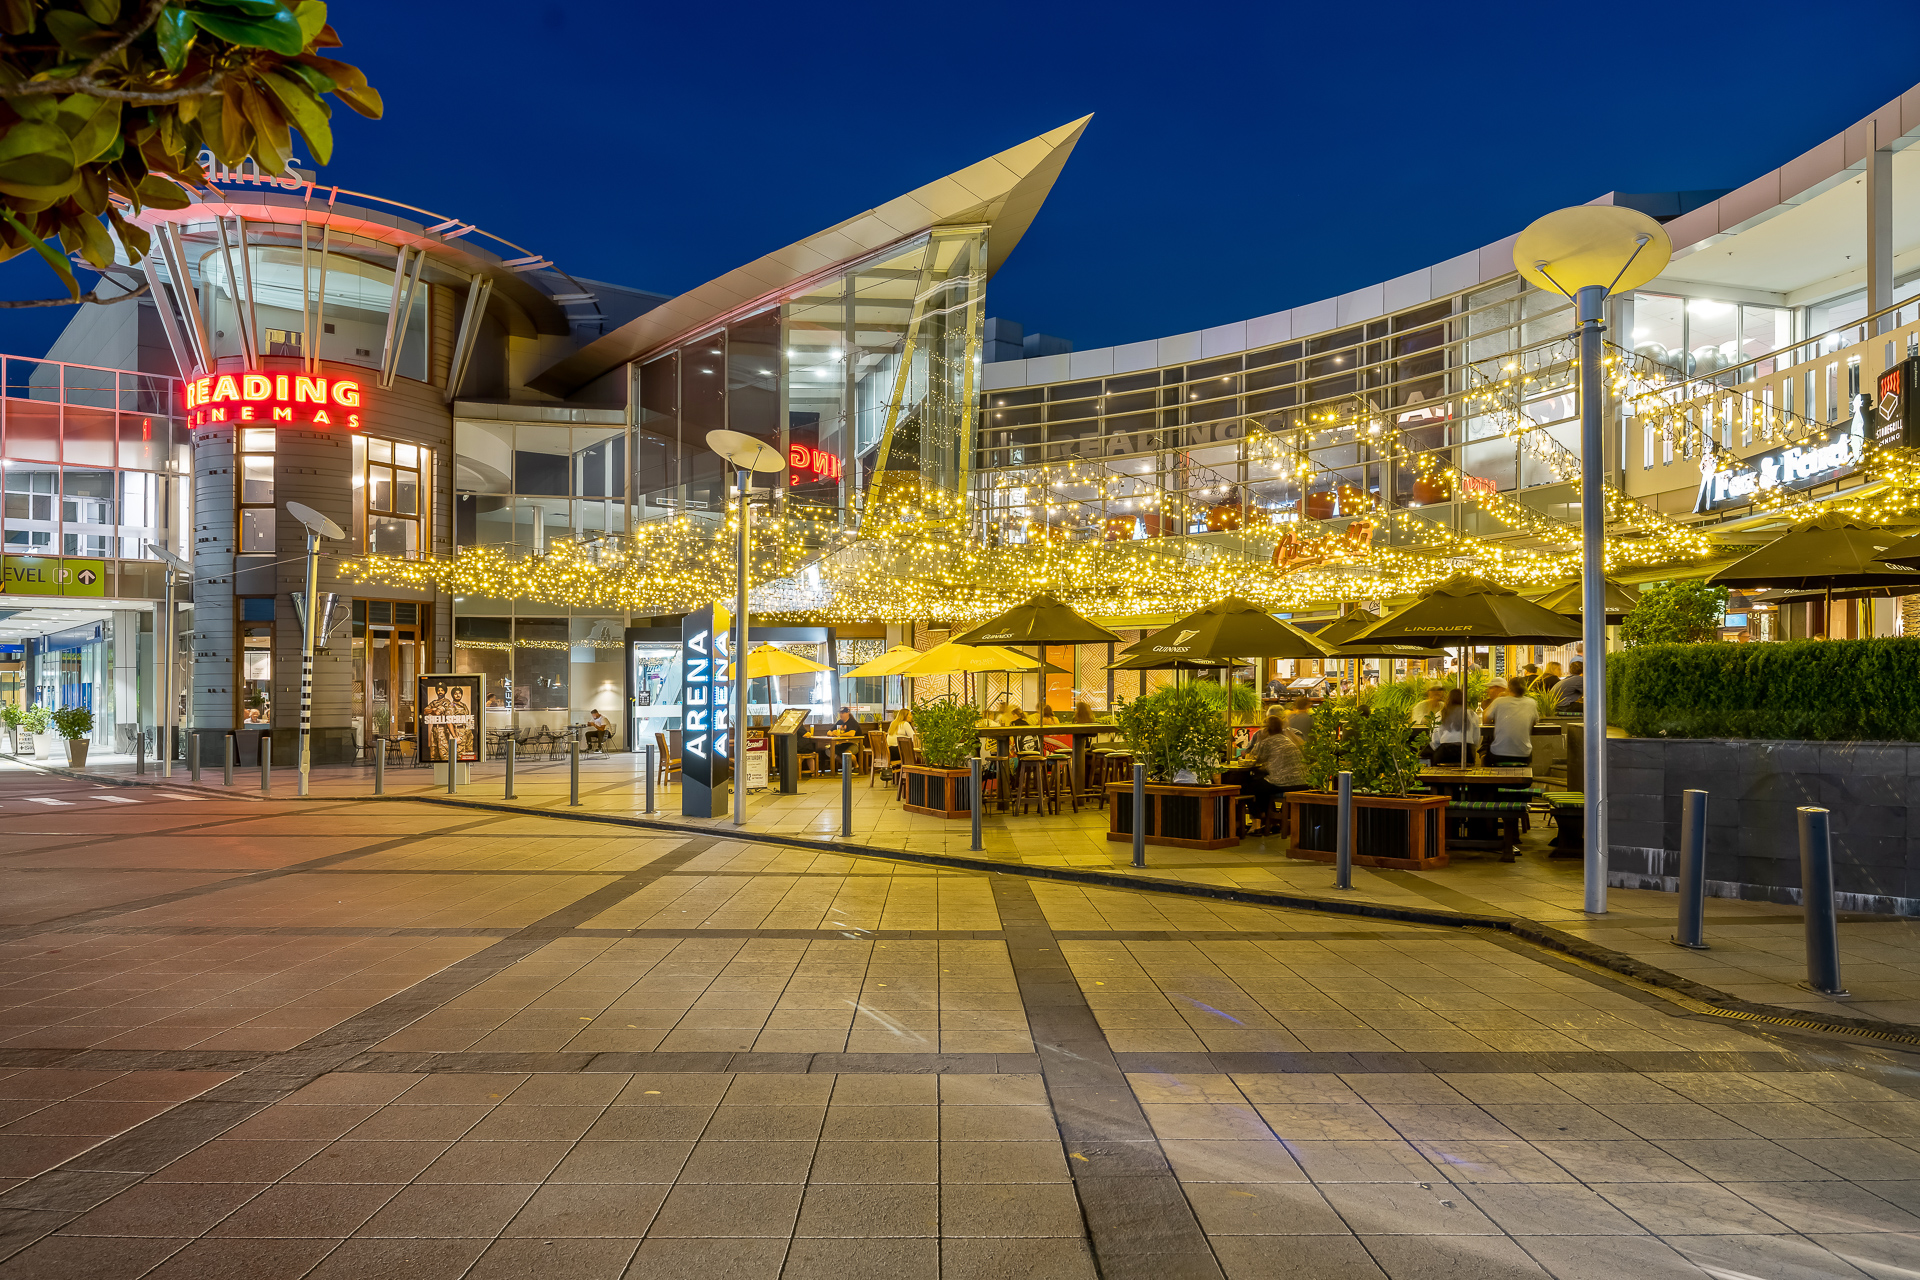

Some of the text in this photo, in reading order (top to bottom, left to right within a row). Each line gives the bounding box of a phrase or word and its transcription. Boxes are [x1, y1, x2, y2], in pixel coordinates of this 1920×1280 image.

[187, 374, 360, 410] READING
[187, 406, 360, 429] CINEMAS
[0, 567, 46, 583] EVEL
[1152, 645, 1191, 653] GUINNESS
[686, 629, 709, 760] ARENA
[713, 630, 729, 759] ARENA
[424, 714, 475, 725] SHELLSCRAPE
